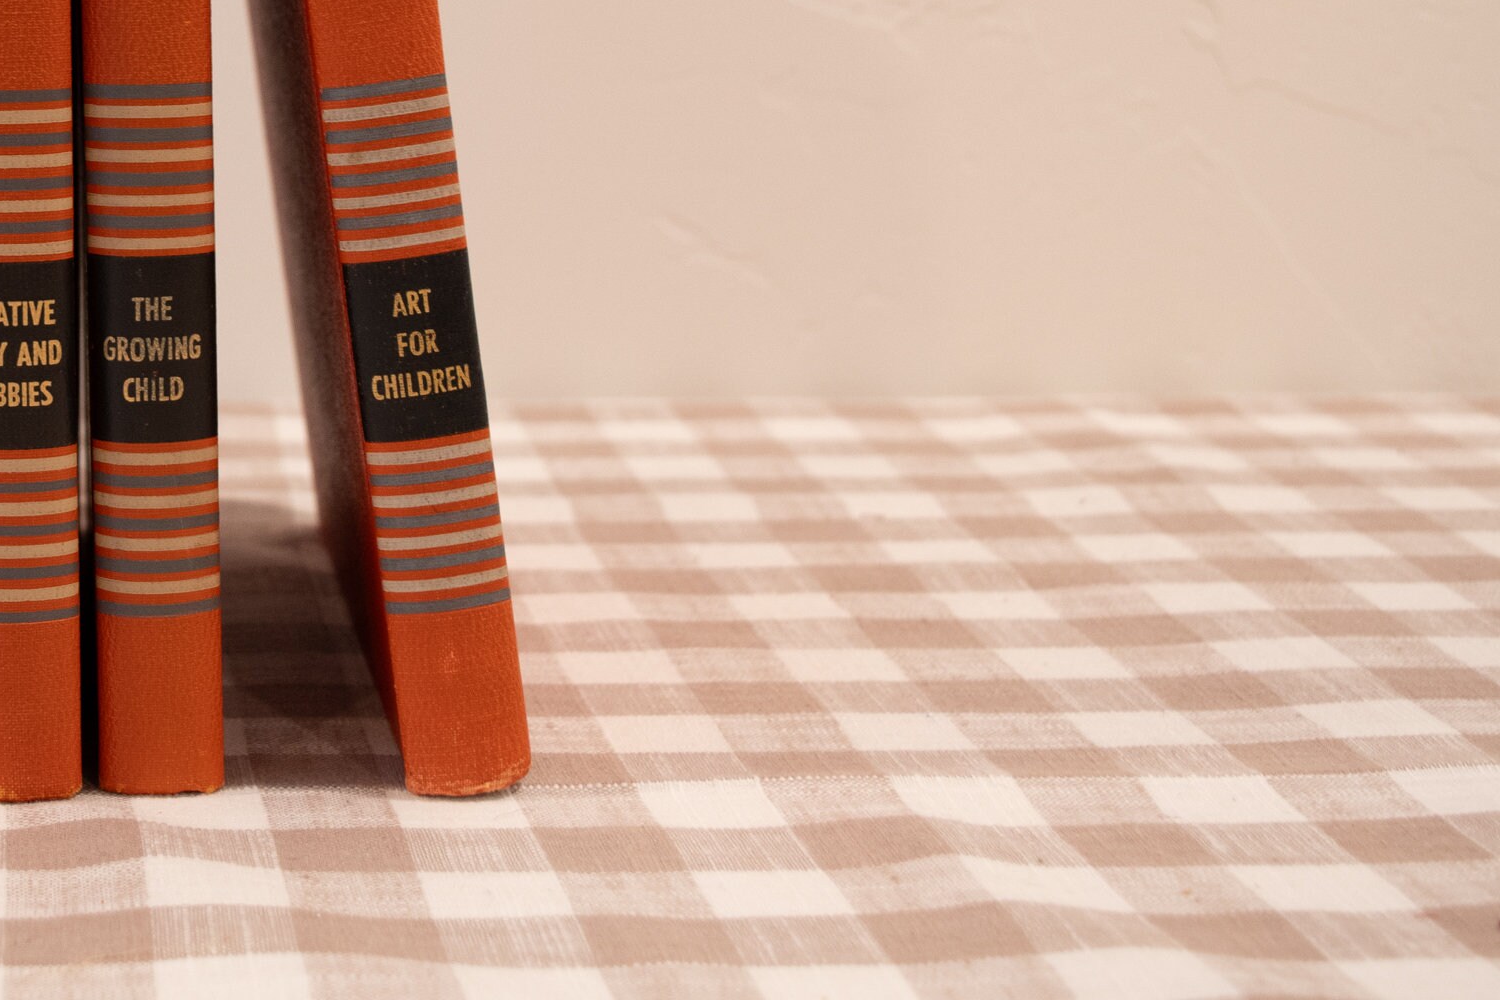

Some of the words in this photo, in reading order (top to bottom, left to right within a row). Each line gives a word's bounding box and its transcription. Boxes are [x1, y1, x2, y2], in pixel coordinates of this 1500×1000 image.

[131, 295, 173, 322] THE
[392, 288, 432, 318] ART
[17, 338, 63, 368] AND
[103, 333, 201, 363] GROWING
[396, 328, 440, 358] FOR
[122, 374, 184, 403] CHILD
[371, 363, 472, 401] CHILDREN
